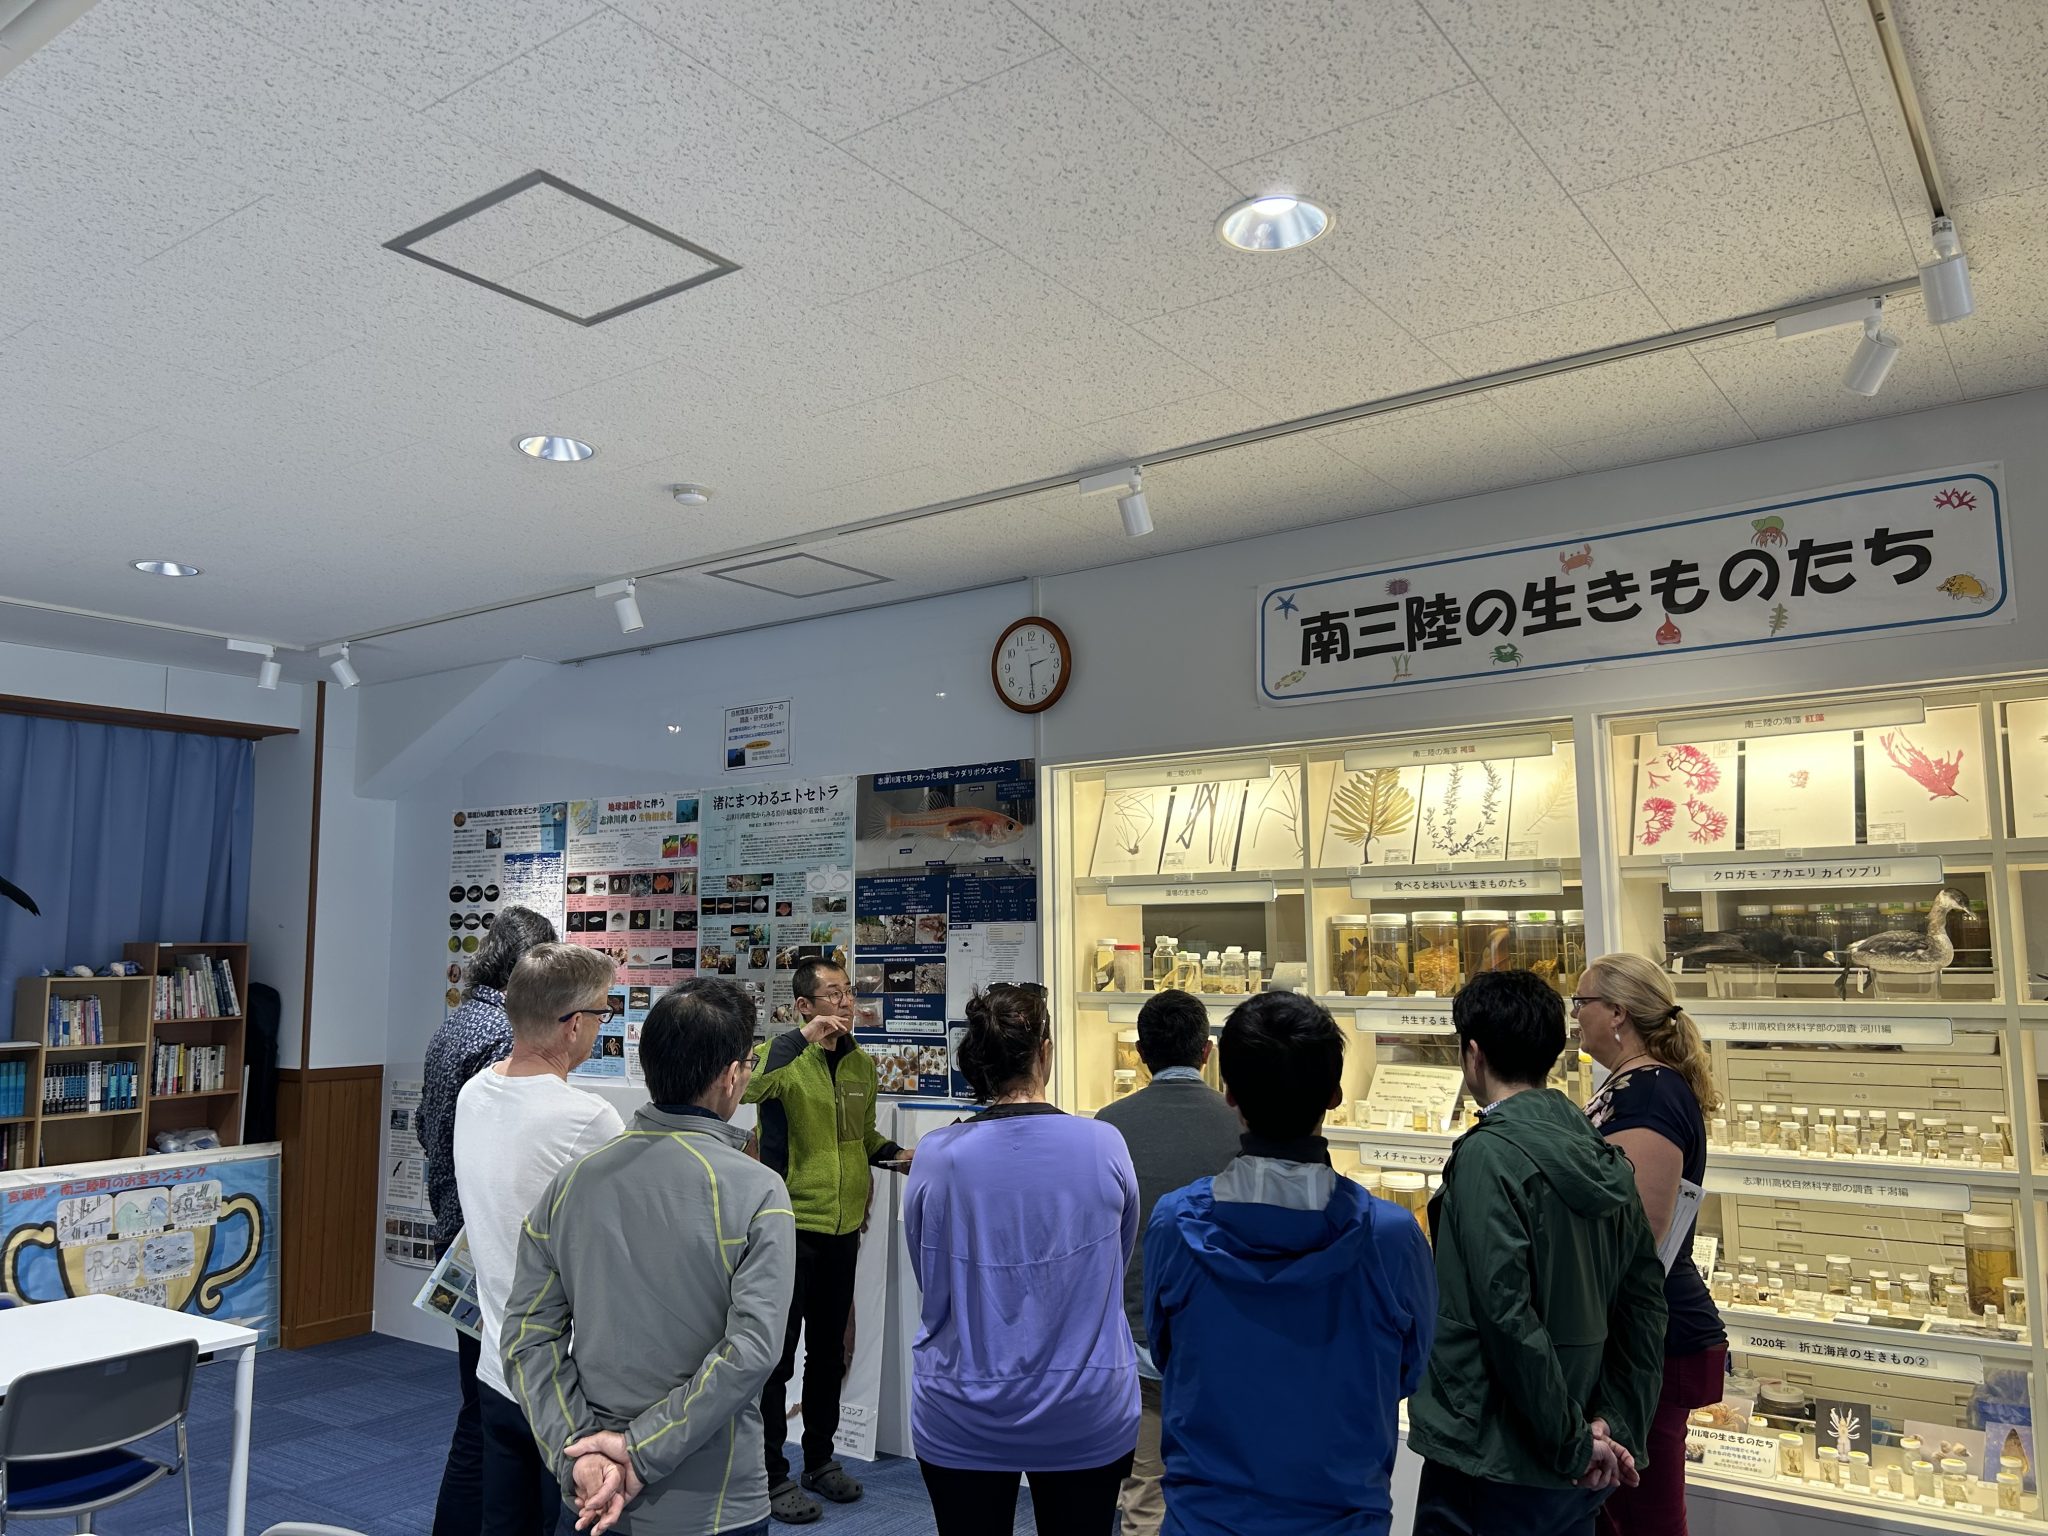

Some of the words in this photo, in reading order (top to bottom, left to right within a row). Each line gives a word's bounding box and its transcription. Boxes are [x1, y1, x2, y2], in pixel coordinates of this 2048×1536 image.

[1299, 526, 1935, 666] 南三陸の生きものたち
[1017, 636, 1023, 647] 11
[1027, 630, 1036, 642] 12
[1042, 633, 1045, 645] 1
[1007, 648, 1016, 659] 10
[1049, 642, 1056, 654] 2
[1004, 663, 1011, 674] 9
[1053, 658, 1060, 669] 3
[1008, 677, 1015, 688] 8
[1050, 673, 1055, 684] 4
[1017, 686, 1024, 697] 7
[1028, 689, 1036, 700] 6
[1041, 684, 1048, 695] 5
[1744, 714, 1802, 729] 南三陸の海藻
[1804, 712, 1825, 723] 紅藻
[713, 784, 840, 811] 渚にまつわるエトセトラ
[608, 800, 642, 812] 地球温暖化
[643, 798, 666, 809] に伴う
[599, 813, 628, 826] 志津川湾
[629, 814, 637, 822] の
[1713, 867, 1817, 880] クロガモ・アカエリ
[1821, 866, 1882, 879] カイツブリ
[1393, 878, 1528, 891] 食べるとおいしい生きものたち
[1401, 1015, 1437, 1026] 共生する
[1728, 1021, 1857, 1034] 志津川高校自然科学部の調査
[1860, 1023, 1892, 1034] 河川編
[1373, 1149, 1445, 1165] ネイチャーセンタ
[7, 1166, 208, 1205] 宮城県・南三陸町のお宝ランキング
[1742, 1175, 1874, 1195] 志津川高校自然科学部の調査
[1879, 1185, 1909, 1198] 干潟編
[1750, 1336, 1786, 1351] 2020年
[1798, 1341, 1929, 1369] 折立海岸の生きもの②
